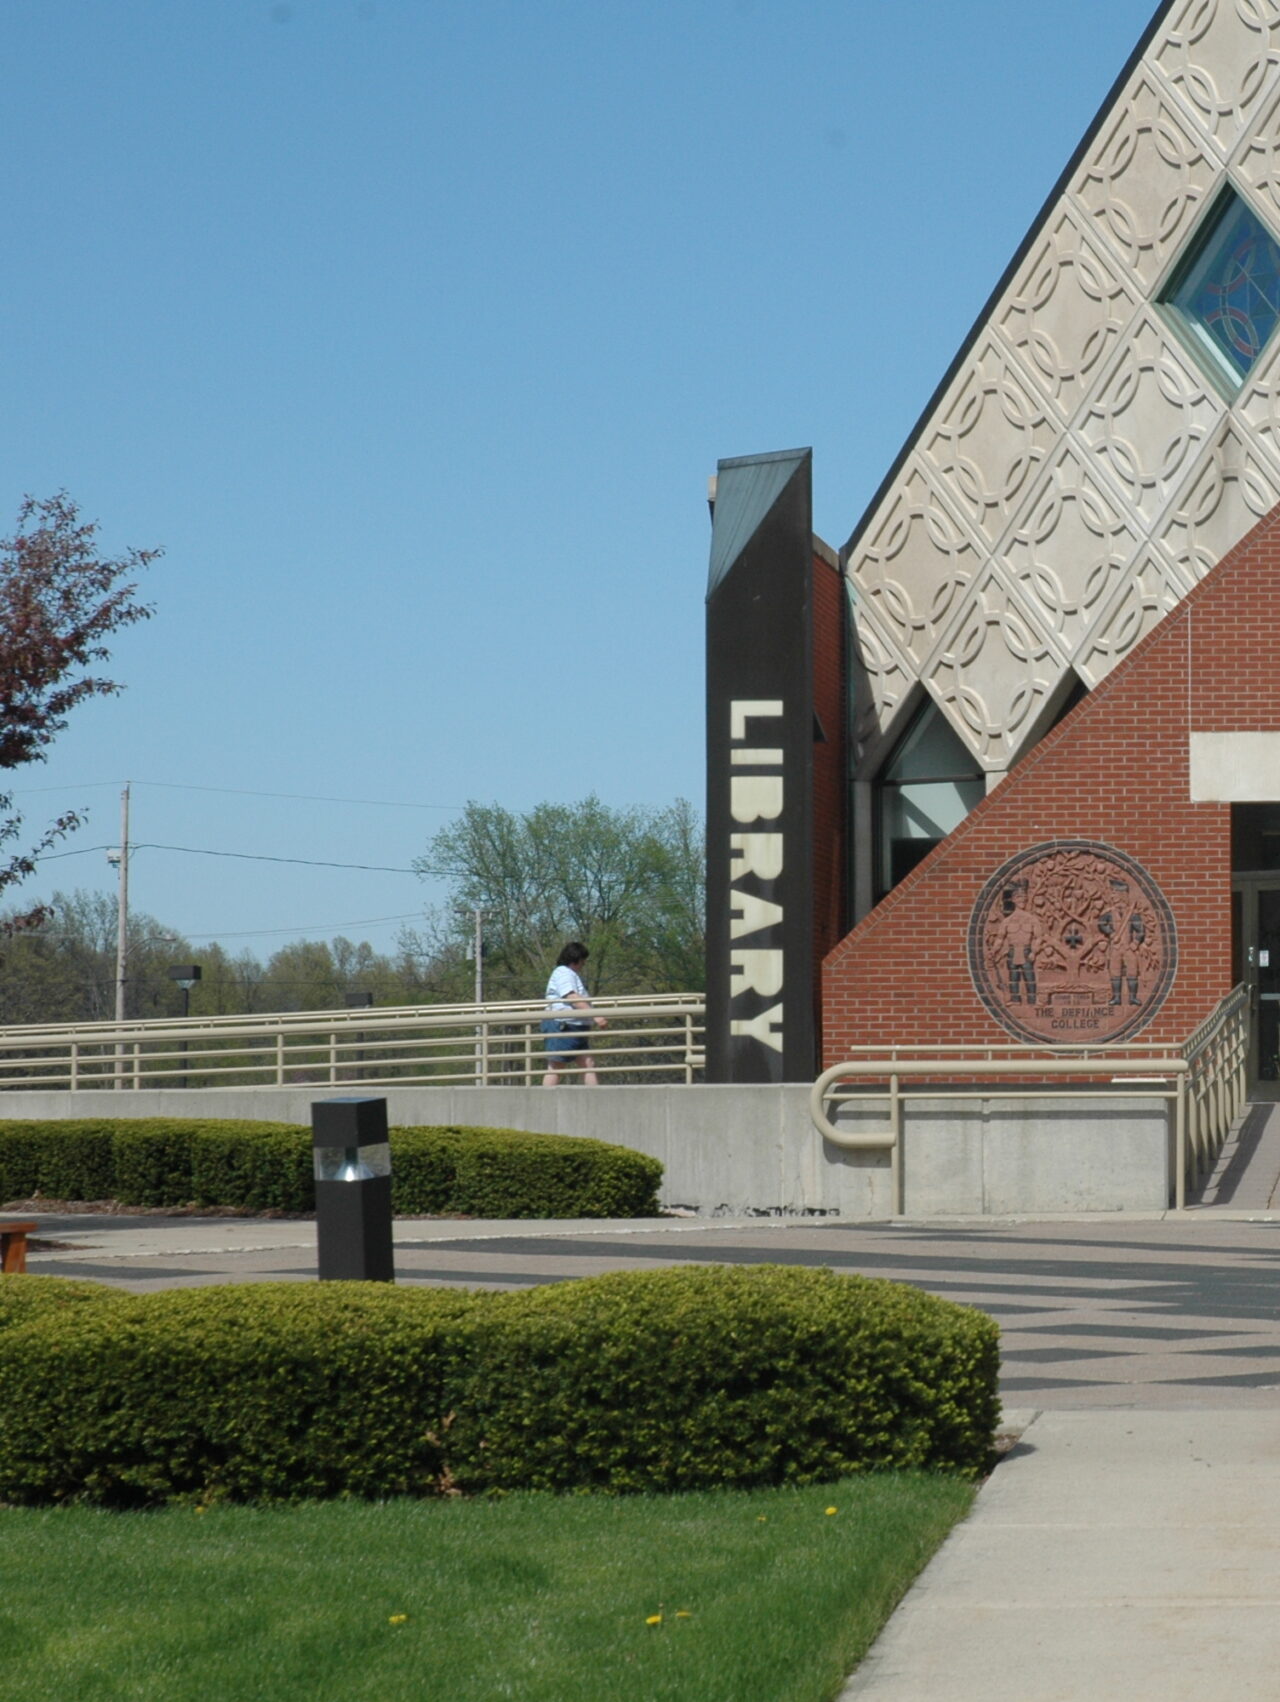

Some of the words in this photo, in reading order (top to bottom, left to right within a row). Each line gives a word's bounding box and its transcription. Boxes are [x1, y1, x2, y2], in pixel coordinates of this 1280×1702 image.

[730, 700, 784, 1053] LIBRARY
[1034, 1007, 1054, 1018] THE
[1061, 1006, 1115, 1017] DEFIANCE
[1051, 1019, 1100, 1029] COLLEGE
